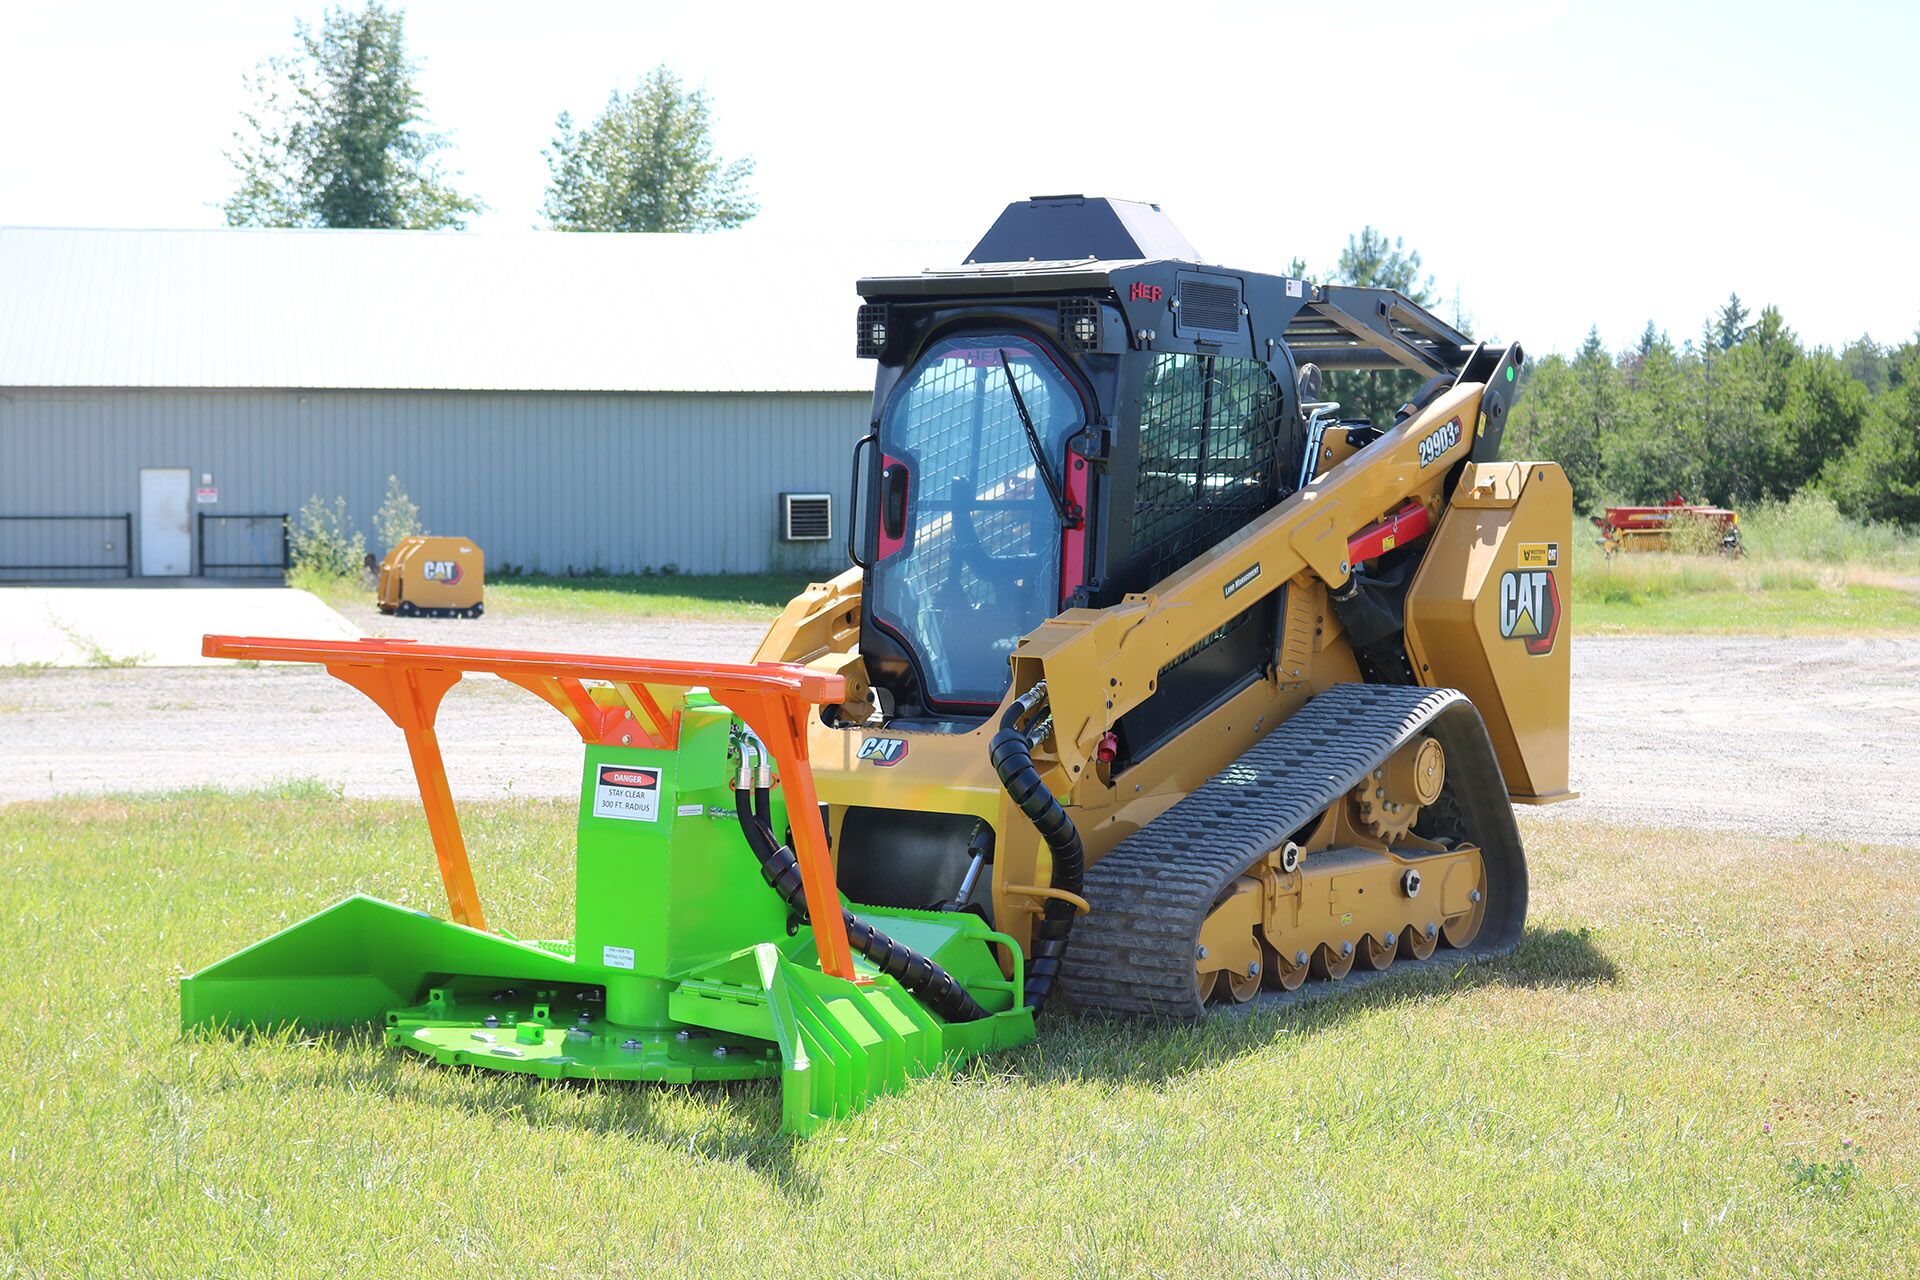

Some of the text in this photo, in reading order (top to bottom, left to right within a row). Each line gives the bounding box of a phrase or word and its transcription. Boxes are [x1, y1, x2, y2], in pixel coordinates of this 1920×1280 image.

[1130, 281, 1162, 303] HER
[1419, 420, 1456, 468] 299D3
[424, 561, 455, 580] CAT
[1500, 572, 1547, 637] CAT
[857, 737, 903, 760] CAT
[613, 773, 642, 784] DANGER
[608, 788, 646, 799] STAY CLEAR
[601, 800, 650, 812] 300 FT. RADIUS
